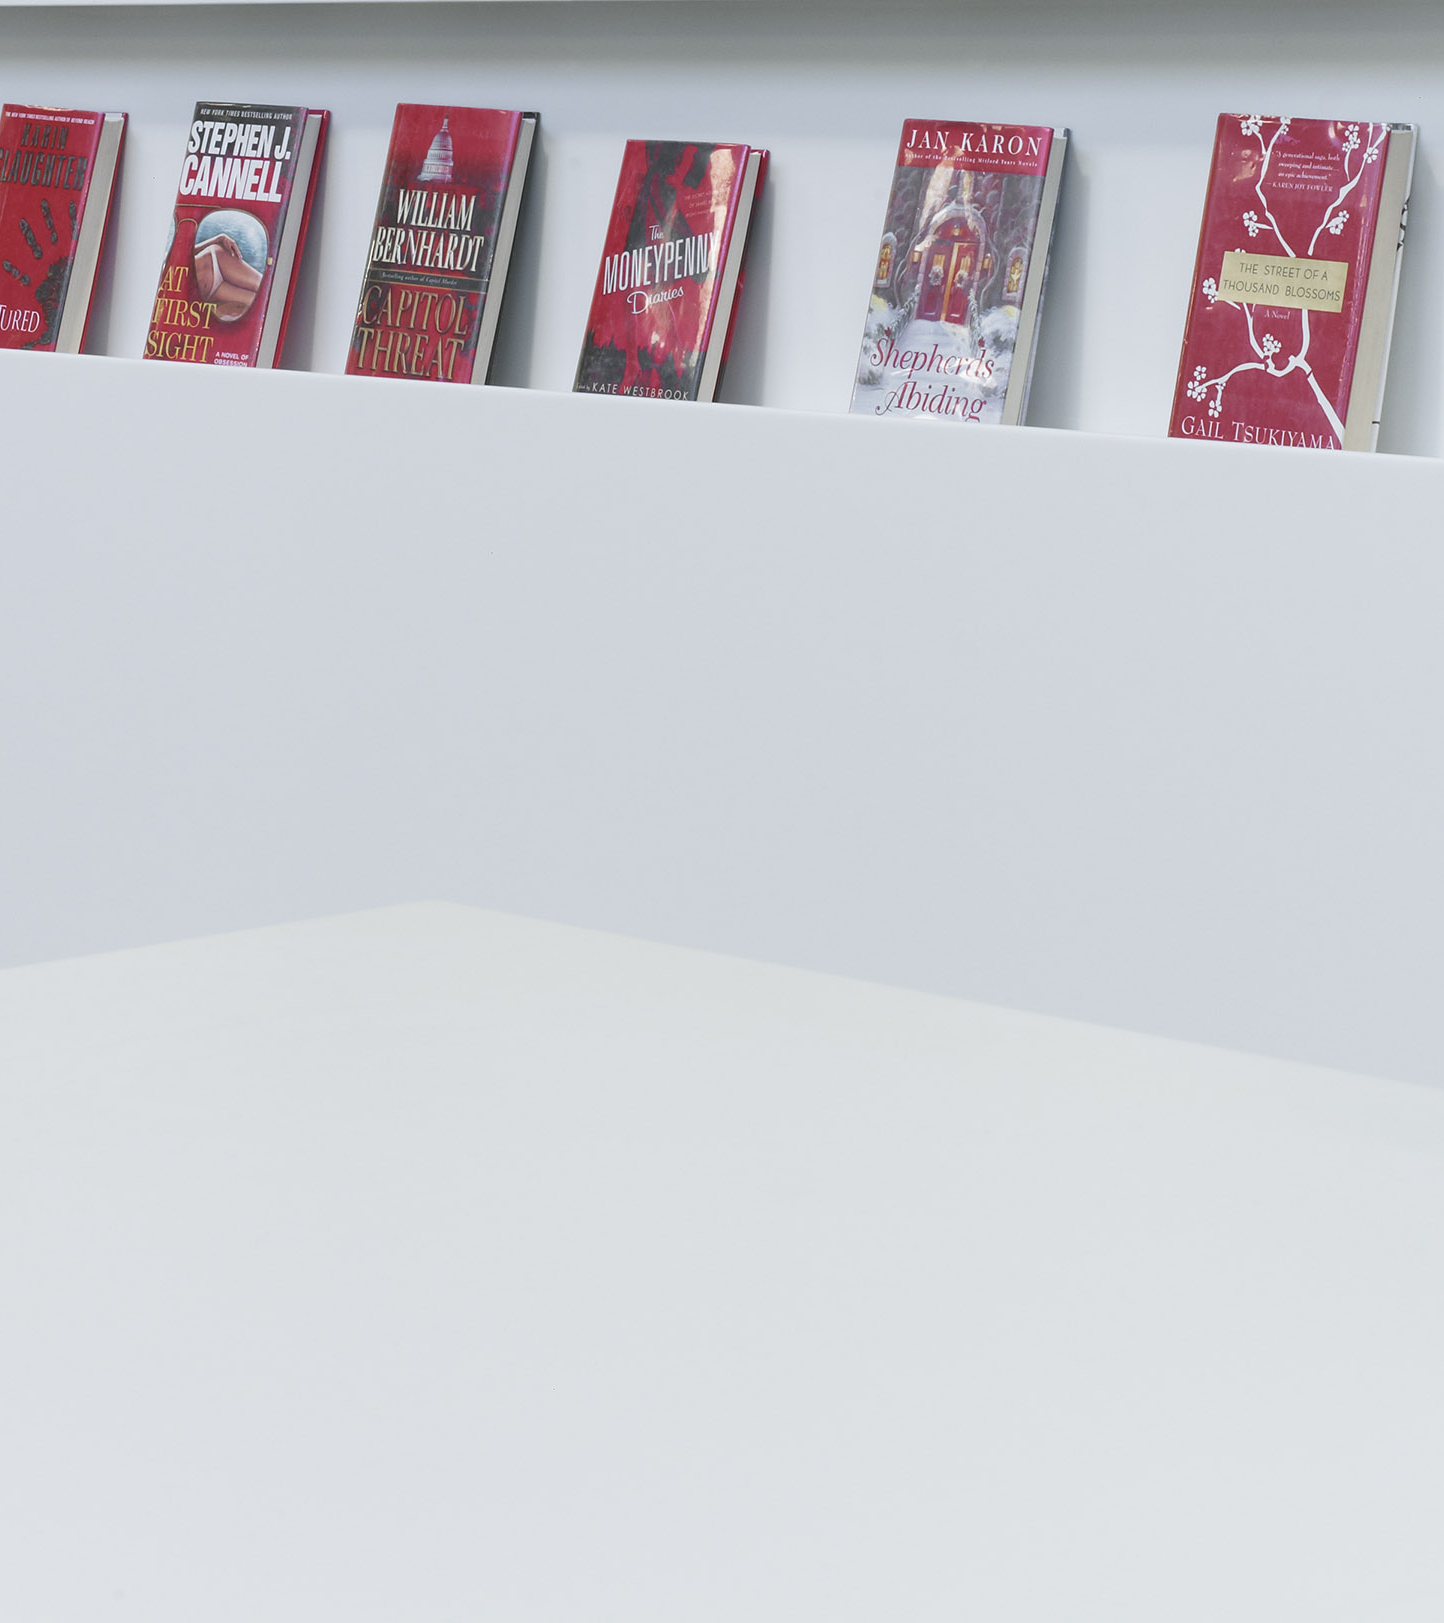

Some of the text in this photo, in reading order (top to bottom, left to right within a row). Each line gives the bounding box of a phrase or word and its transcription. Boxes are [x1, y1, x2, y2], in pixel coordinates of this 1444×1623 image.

[241, 111, 273, 119] BESTSELLING
[20, 123, 70, 150] KARIN
[187, 120, 291, 160] STEPHEN J.
[907, 129, 1042, 156] JAN KARON
[179, 154, 282, 203] CANNELL
[396, 188, 477, 232] WILLIAM
[649, 224, 664, 241] The
[372, 227, 484, 272] BERNHARDT
[602, 231, 720, 295] MONEYPENNY
[159, 266, 189, 292] AT
[1239, 262, 1328, 281] THE STREET OF A
[627, 286, 684, 315] Diaries
[1223, 279, 1341, 302] THOUSAND BLOSSOMS
[151, 298, 218, 329] FIRST
[361, 285, 469, 336] CAPITOL
[1264, 310, 1290, 320] A Novel
[145, 329, 214, 364] SIGHT
[221, 352, 239, 360] NOVEL
[356, 328, 464, 380] THREAT
[870, 337, 995, 380] Shepherds
[592, 382, 618, 394] KATE
[623, 386, 689, 401] WESTBROOK
[875, 380, 987, 423] Abiding
[1181, 415, 1336, 451] GAIL TSUKIYAMA
